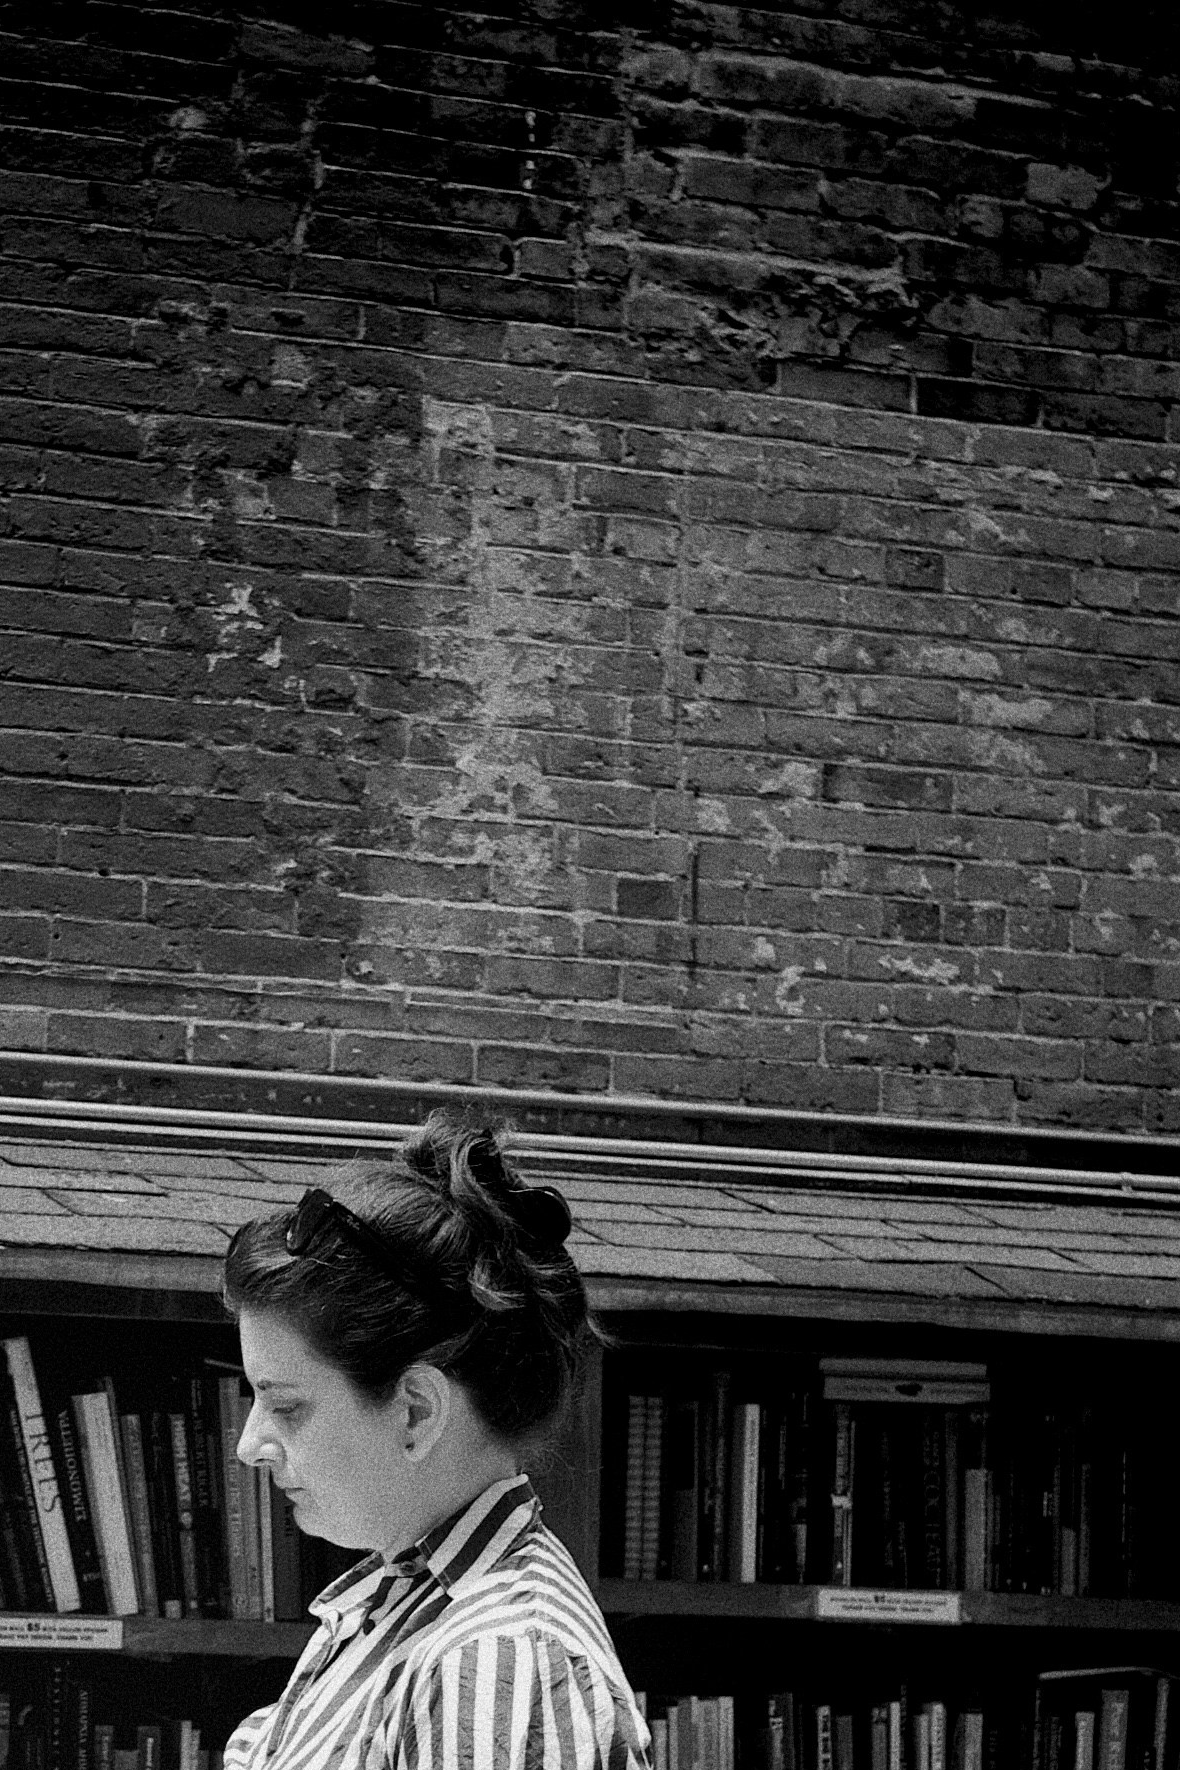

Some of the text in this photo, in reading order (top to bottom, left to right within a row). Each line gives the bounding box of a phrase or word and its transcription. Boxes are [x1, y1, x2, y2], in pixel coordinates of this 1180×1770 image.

[18, 1407, 70, 1514] TREES
[170, 1419, 193, 1504] HIGH HEAT
[26, 1622, 41, 1632] $5
